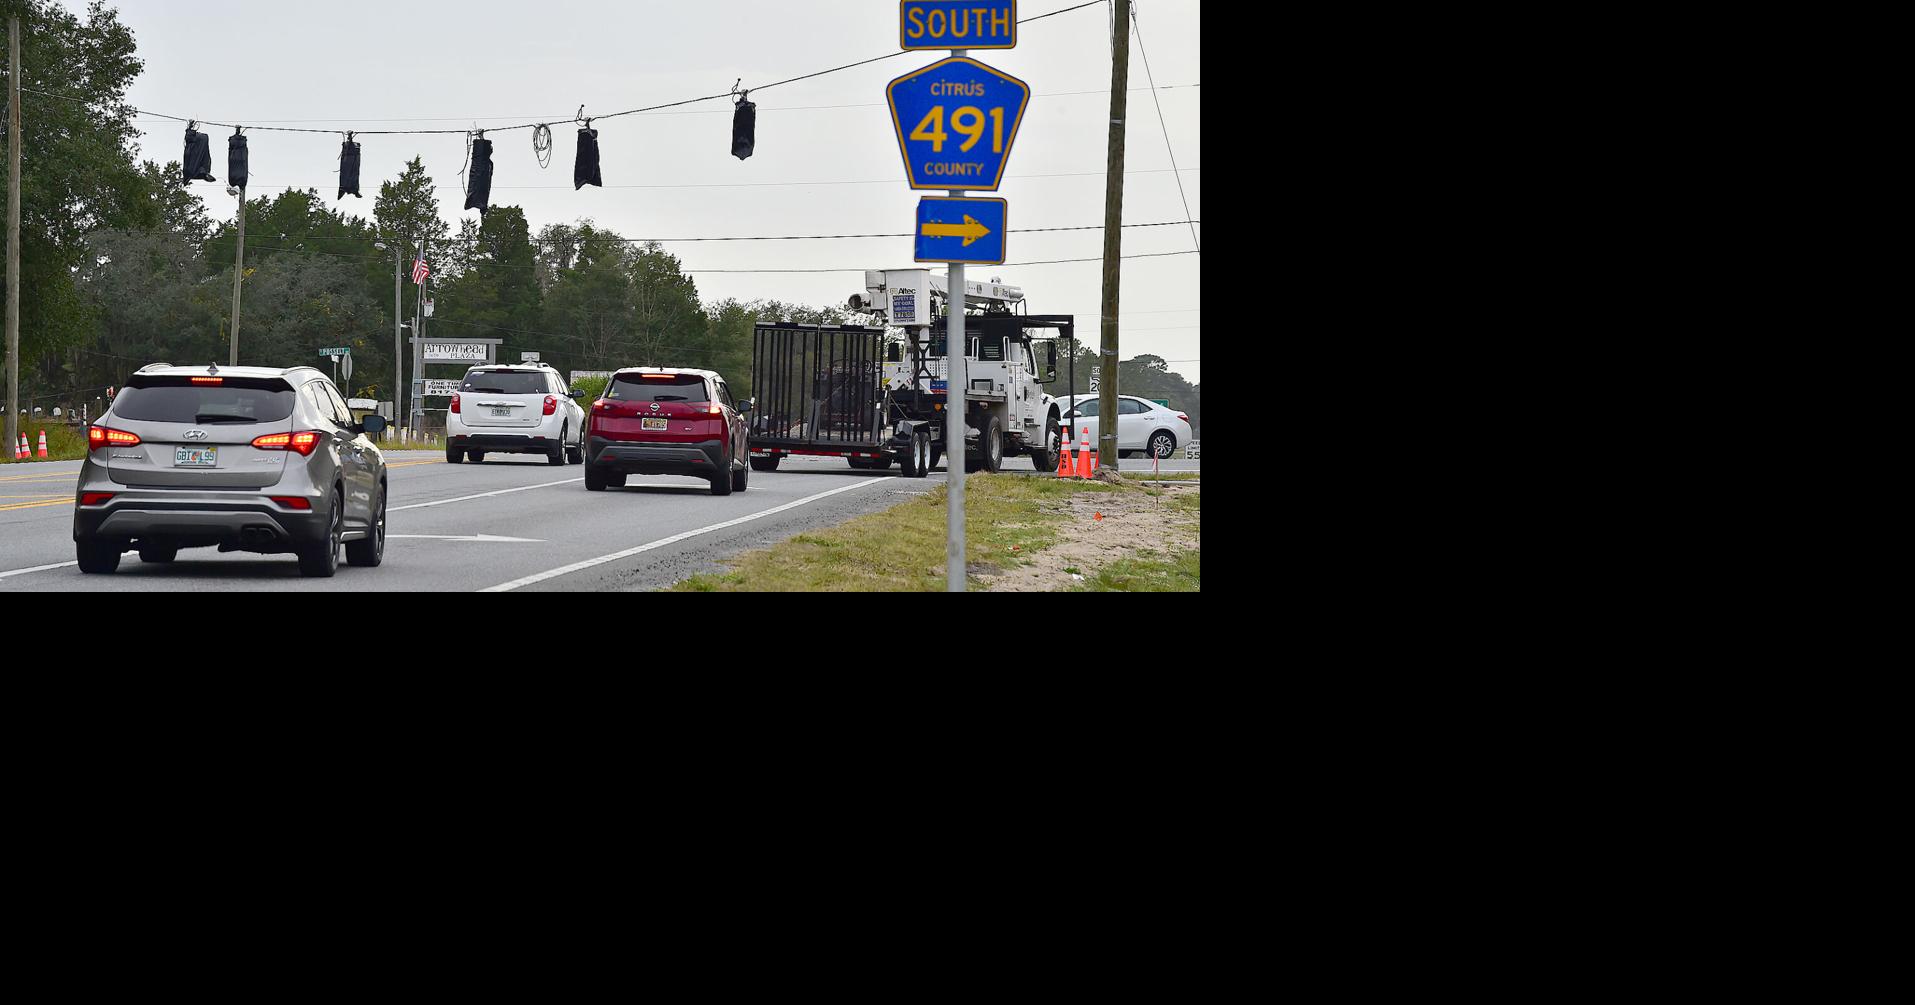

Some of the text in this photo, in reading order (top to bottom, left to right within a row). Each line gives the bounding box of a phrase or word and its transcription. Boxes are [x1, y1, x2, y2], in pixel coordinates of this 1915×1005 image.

[907, 7, 1010, 38] SOUTH
[930, 81, 985, 97] CITRUS
[909, 105, 1004, 154] 491
[924, 162, 985, 176] COUNTY
[1186, 451, 1200, 460] 55
